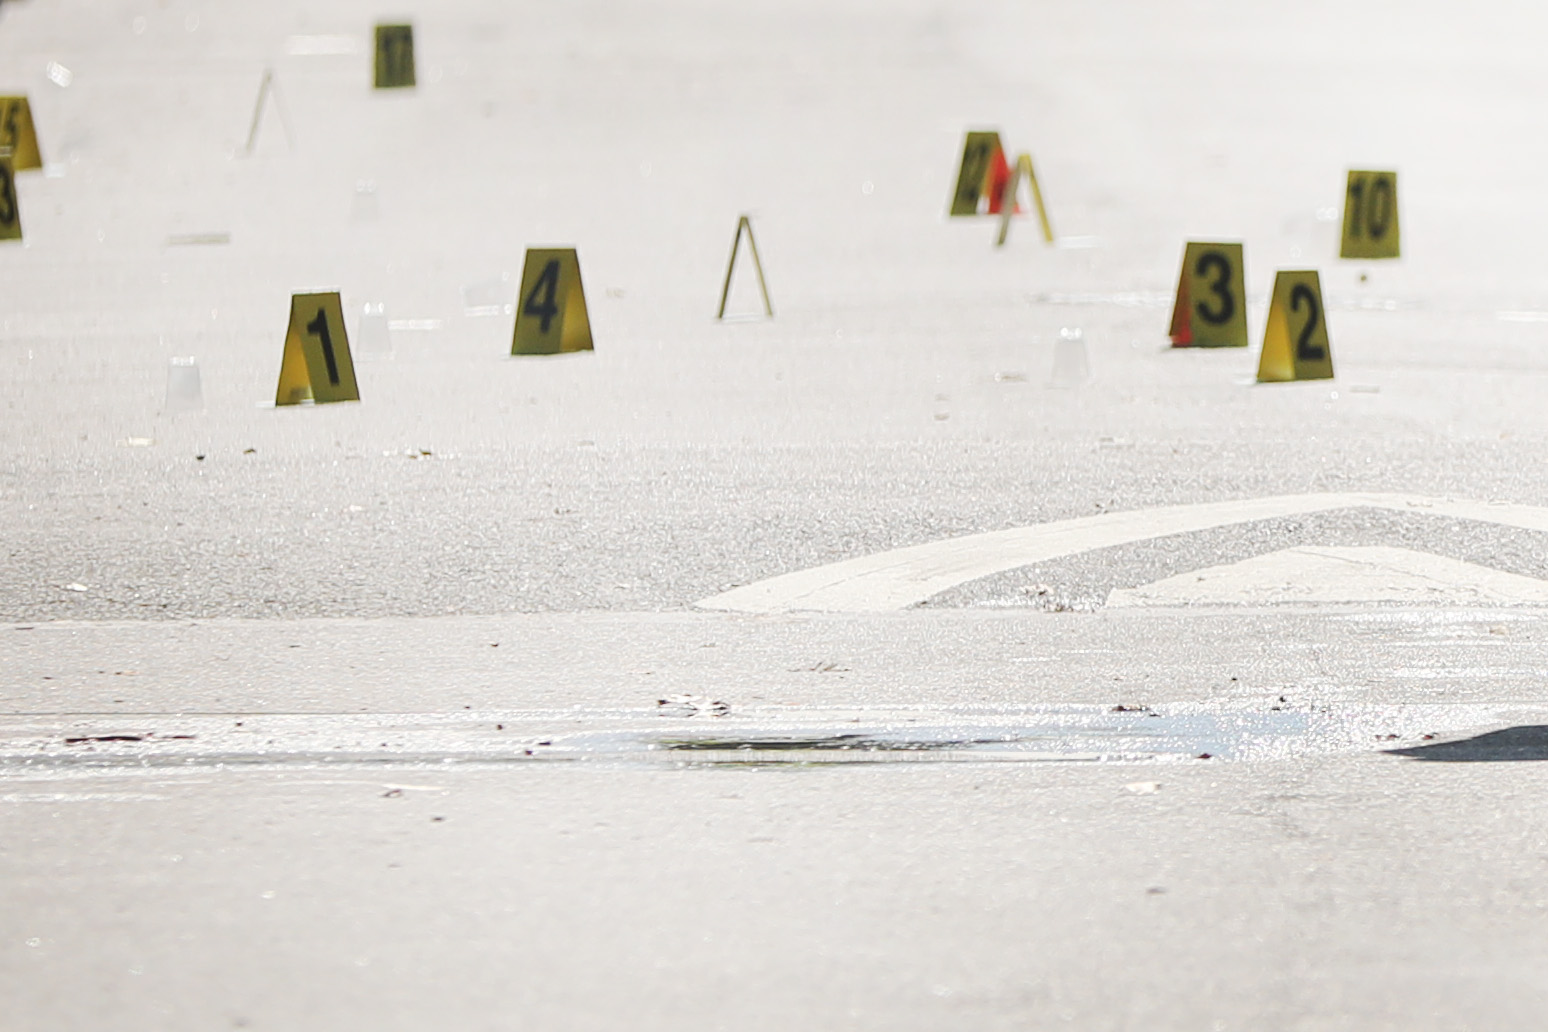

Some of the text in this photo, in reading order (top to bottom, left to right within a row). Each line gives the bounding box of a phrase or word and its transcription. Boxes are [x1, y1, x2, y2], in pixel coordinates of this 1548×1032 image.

[1350, 175, 1392, 240] 10
[523, 257, 559, 335] 4
[1195, 249, 1235, 325] 3
[1290, 282, 1325, 361] 2
[306, 306, 340, 386] 1
